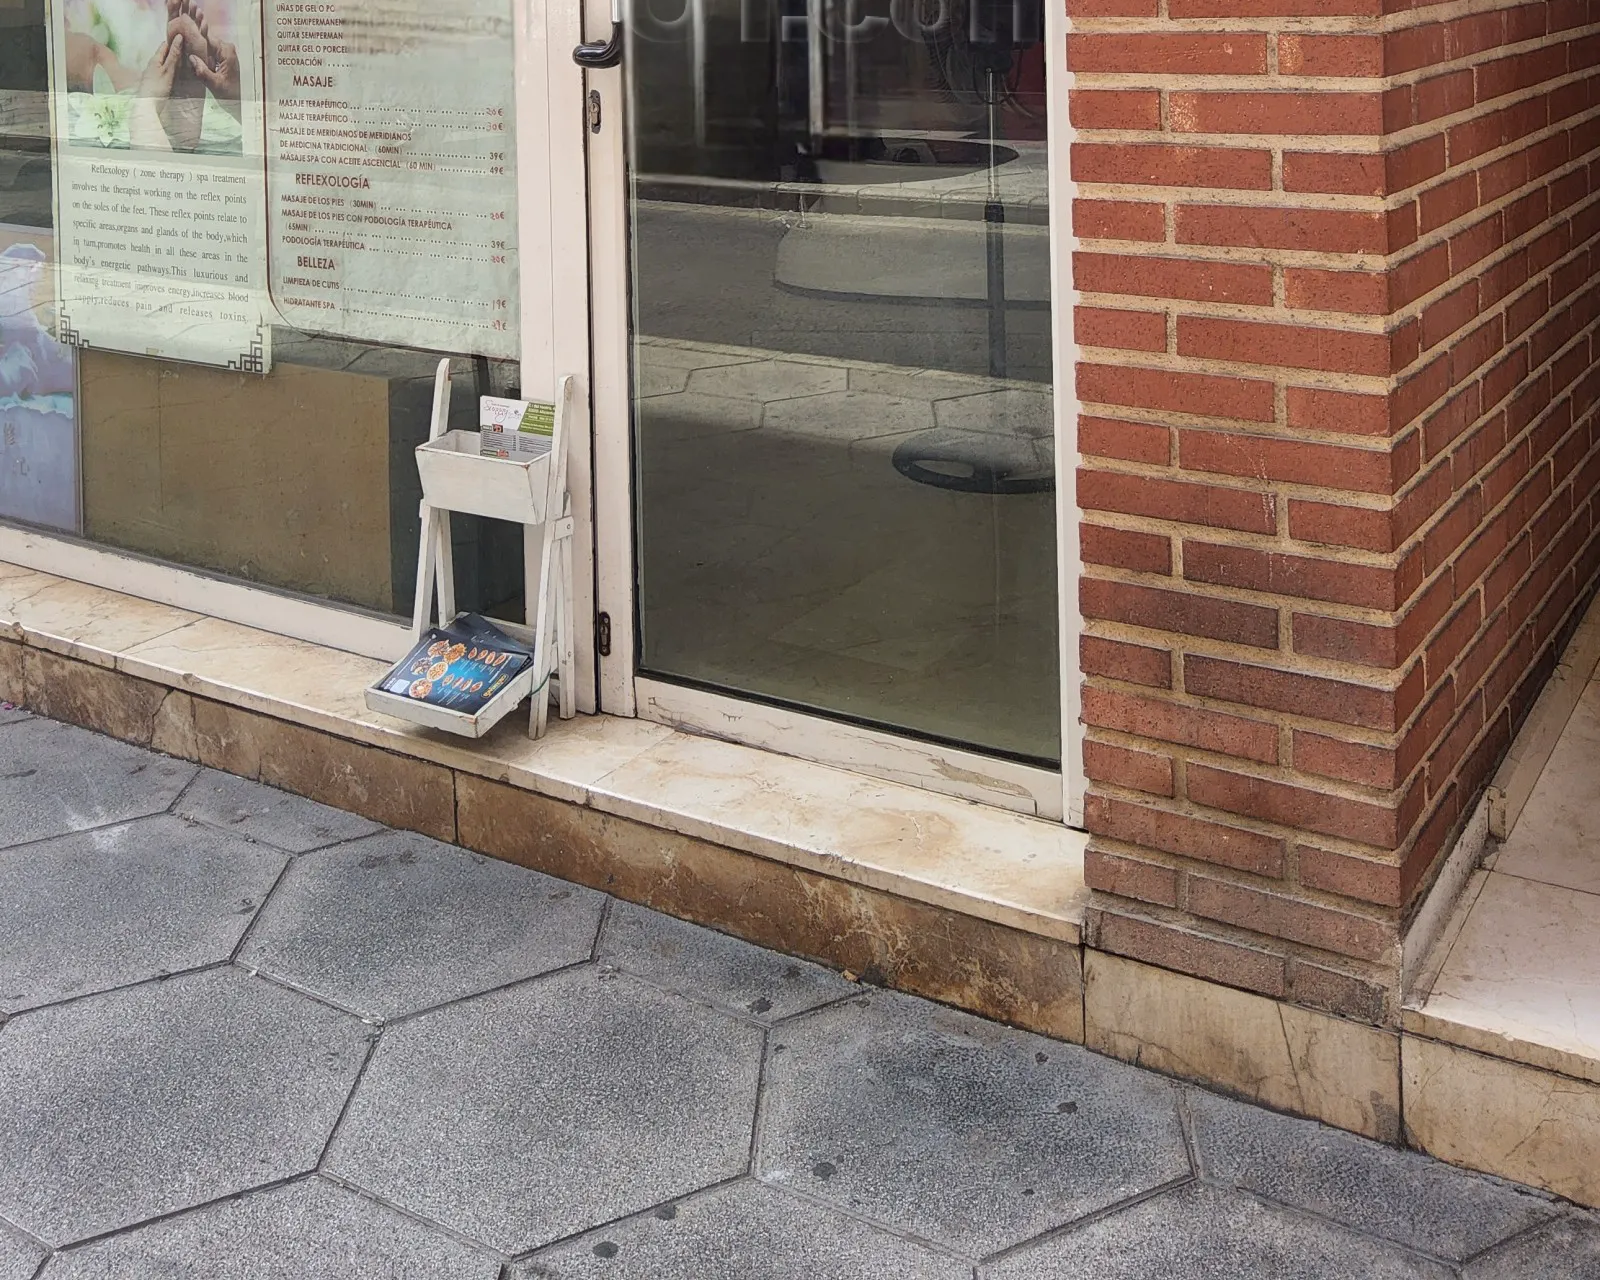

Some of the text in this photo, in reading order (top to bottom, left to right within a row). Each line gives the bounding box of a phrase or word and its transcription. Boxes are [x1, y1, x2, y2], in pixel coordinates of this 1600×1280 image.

[277, 55, 323, 66] DECORACIÓN
[292, 75, 333, 87] MASAJE
[279, 139, 288, 148] DE
[288, 140, 322, 149] MEDICINA
[322, 142, 370, 152] TRADICIONAL
[489, 151, 504, 160] 39€
[294, 173, 370, 189] REFLEXOLOGÍA
[71, 180, 247, 204] involves the therapist working on the reflex points
[280, 194, 307, 203] MASAJE
[307, 195, 317, 204] DE
[316, 196, 331, 206] LOS
[330, 197, 345, 206] PIES
[280, 208, 452, 230] MASAJE DE LOS PIES CON PODOLOGÍA TERAPÉUTICA
[72, 218, 248, 243] specific areas,organs and glands of the body,which
[296, 255, 335, 270] BELLEZA
[282, 276, 340, 289] LIMPIEZA DE CUTIS
[282, 297, 335, 310] HIDRATANTE SPA
